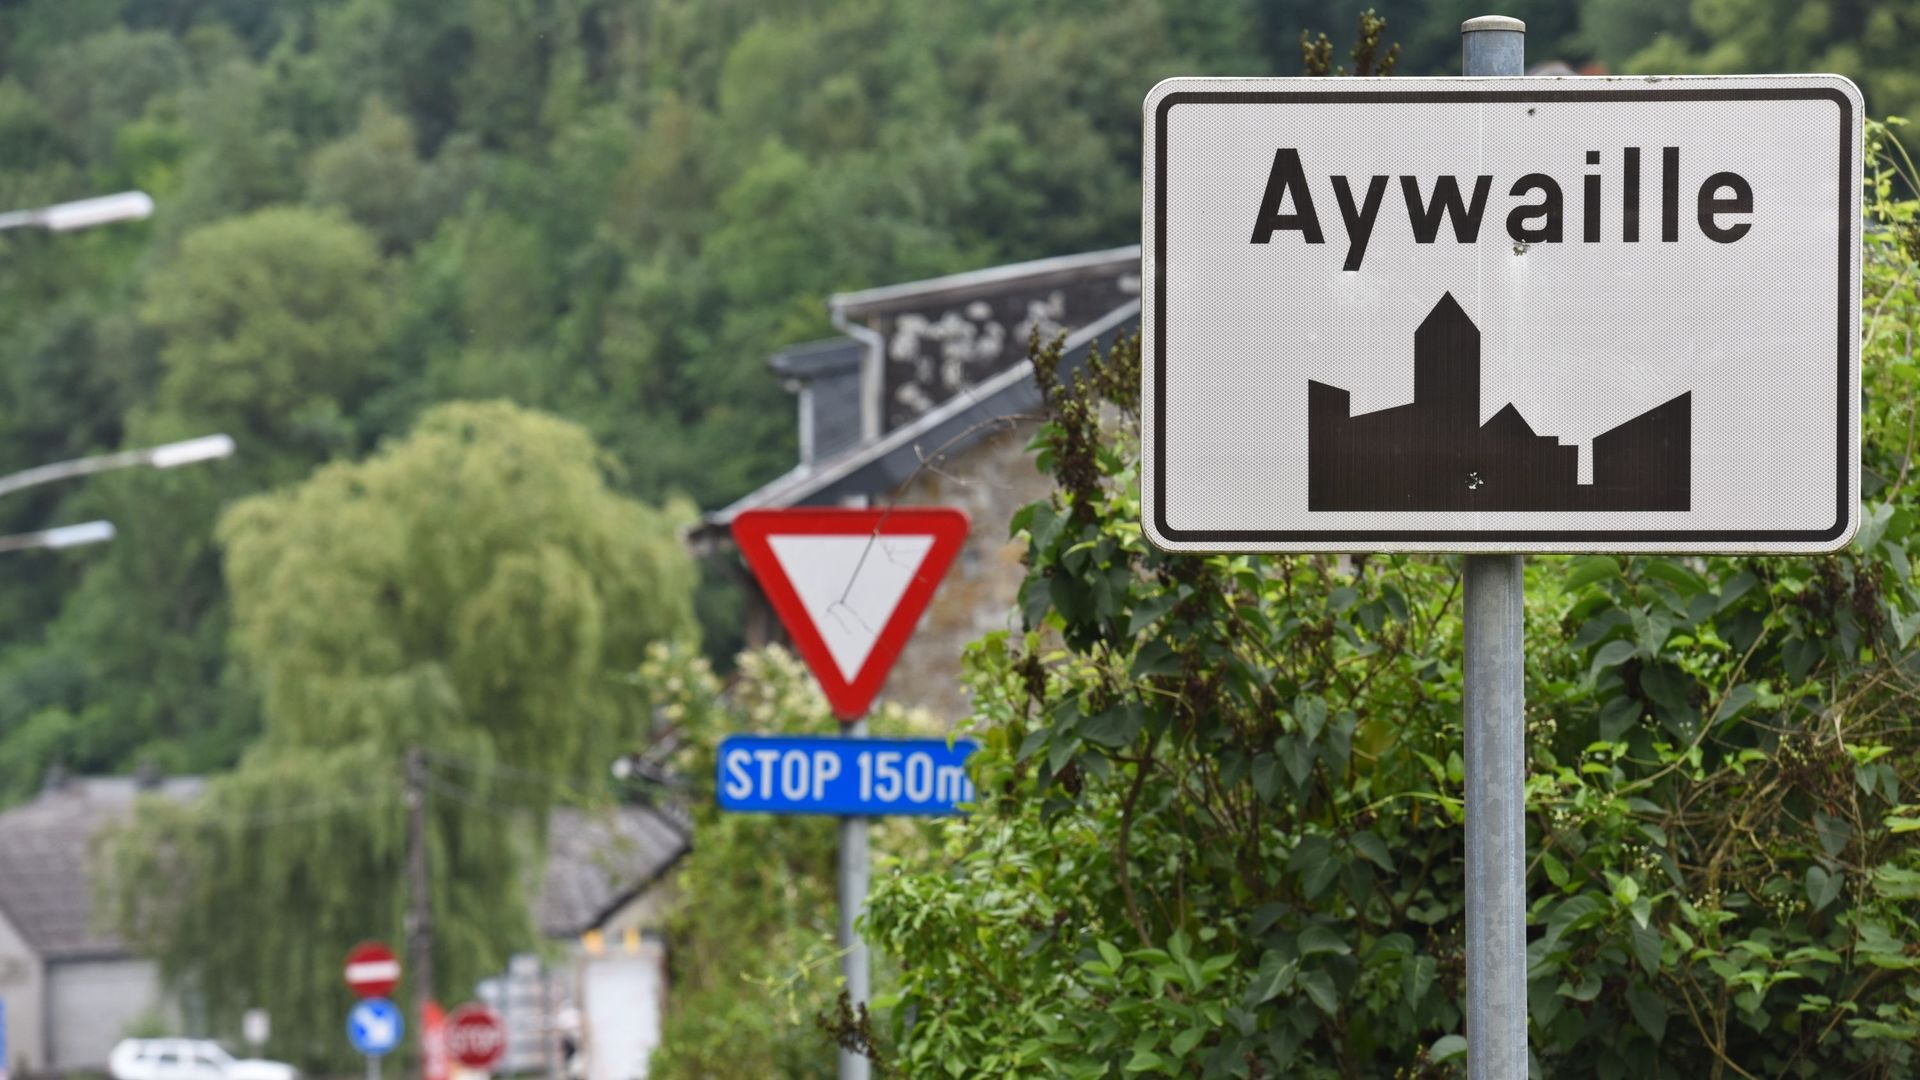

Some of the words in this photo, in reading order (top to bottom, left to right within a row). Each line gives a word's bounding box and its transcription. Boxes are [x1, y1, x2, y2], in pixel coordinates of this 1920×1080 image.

[1250, 146, 1754, 271] Aywaille
[726, 749, 842, 801] STOP
[857, 751, 975, 803] 150m
